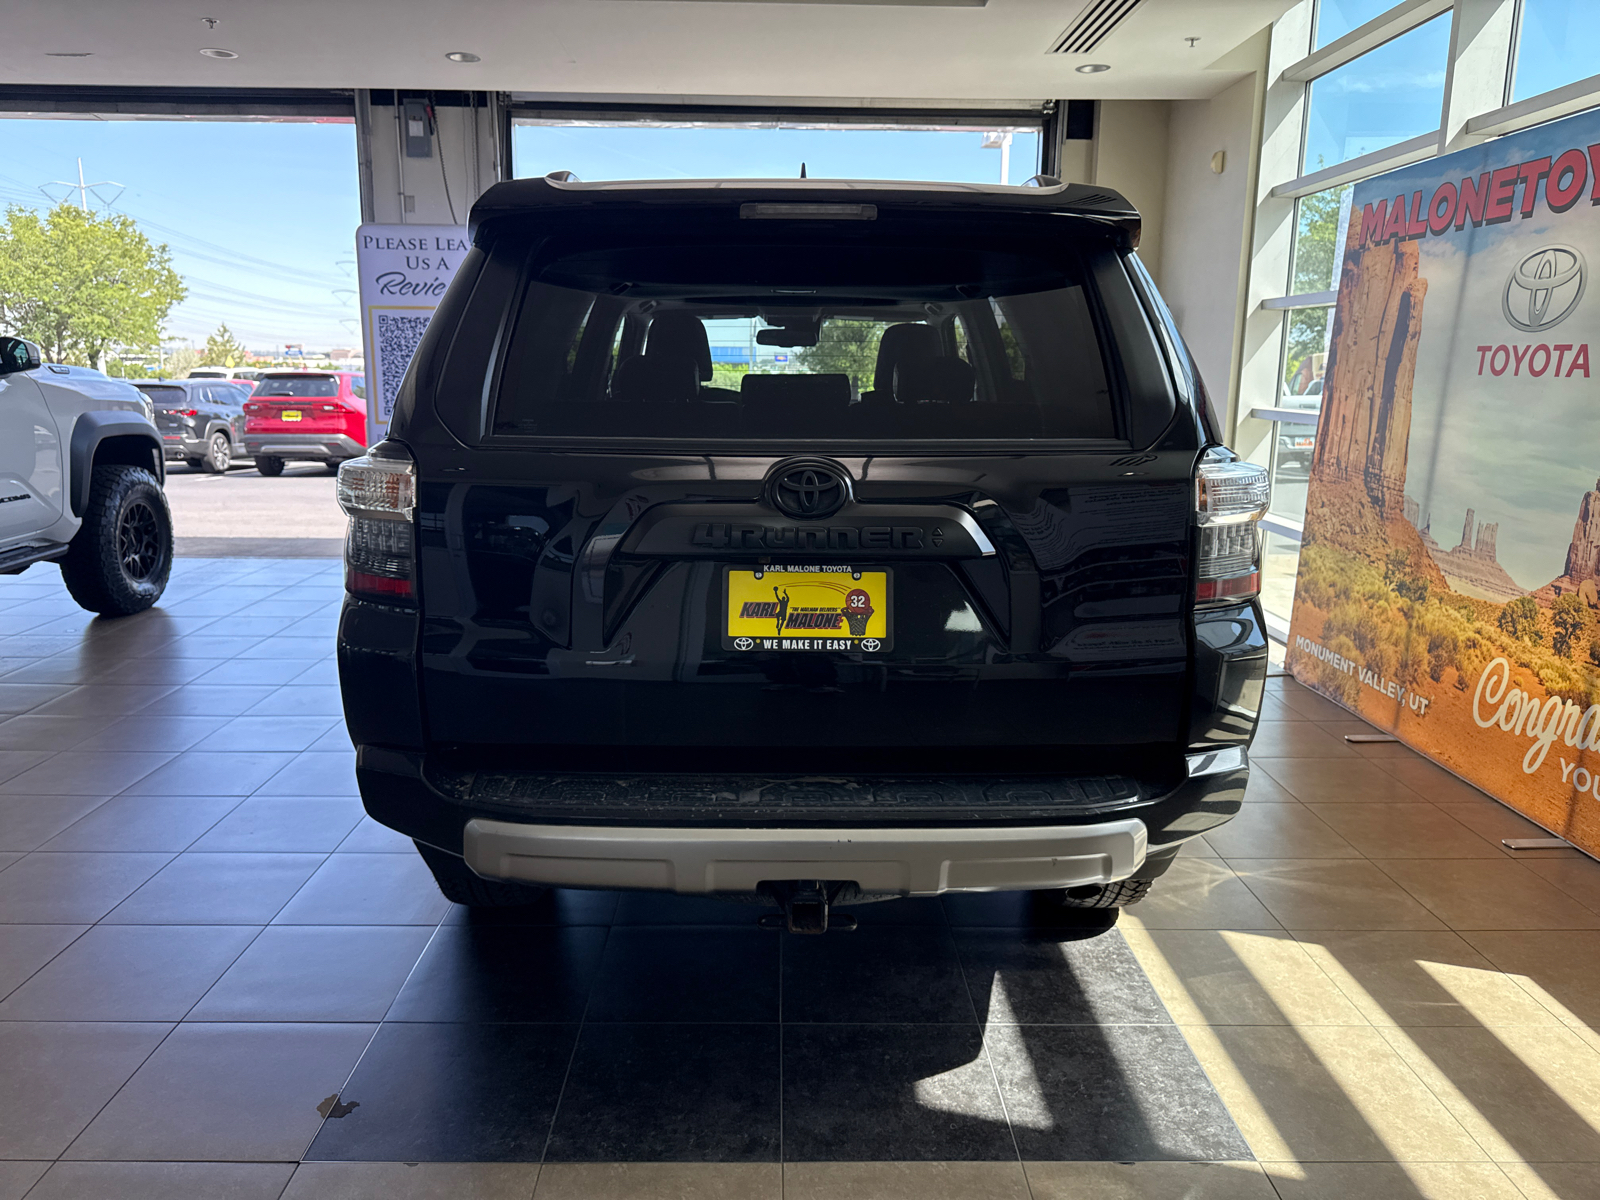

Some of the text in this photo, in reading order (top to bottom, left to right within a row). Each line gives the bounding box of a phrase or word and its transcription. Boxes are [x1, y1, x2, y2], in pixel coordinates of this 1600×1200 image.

[363, 235, 428, 250] PLEASE
[405, 256, 450, 270] US A
[1476, 343, 1591, 378] TOYOTA
[822, 565, 852, 573] TOYOTA
[850, 595, 865, 608] 32
[739, 602, 779, 618] KARL
[784, 613, 843, 629] MALONE
[763, 639, 852, 650] WE MAKE IT EASY
[1295, 634, 1429, 715] MONUMENT VALLEY, UT
